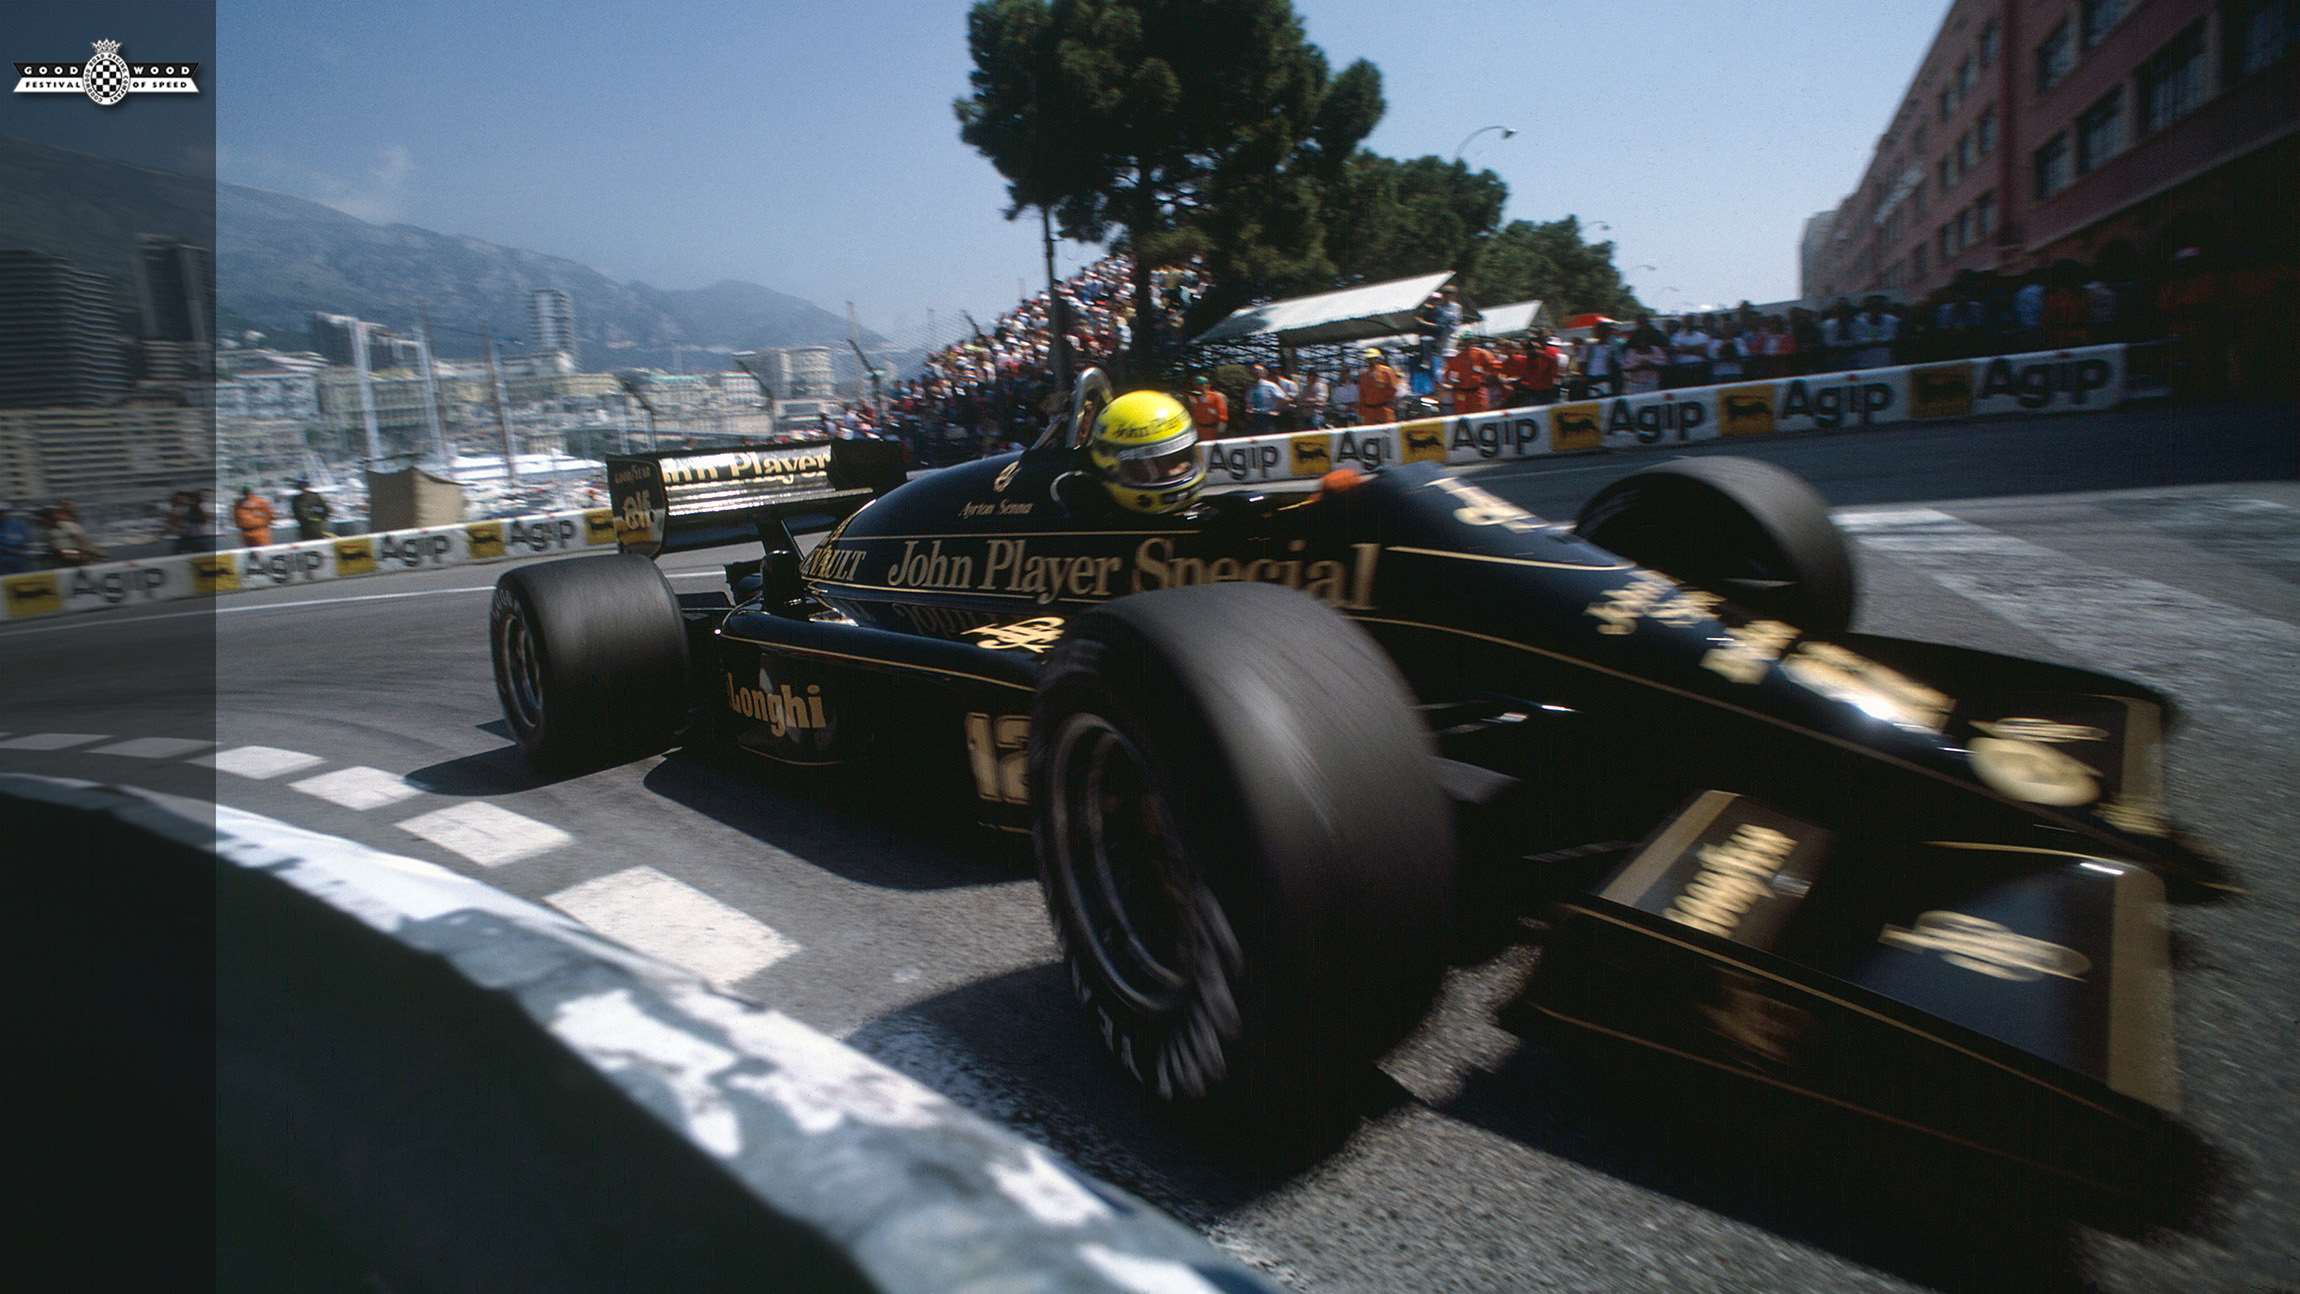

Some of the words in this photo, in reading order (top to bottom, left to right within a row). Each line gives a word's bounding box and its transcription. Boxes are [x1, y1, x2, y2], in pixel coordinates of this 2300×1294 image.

[1606, 398, 1705, 442] Agip
[1782, 380, 1893, 427] Agip
[1452, 417, 1539, 458] Agip
[1207, 443, 1278, 480] Agip
[508, 519, 575, 551] Agip
[887, 540, 973, 588] John
[977, 539, 1123, 605] Player
[727, 671, 826, 737] Longhi
